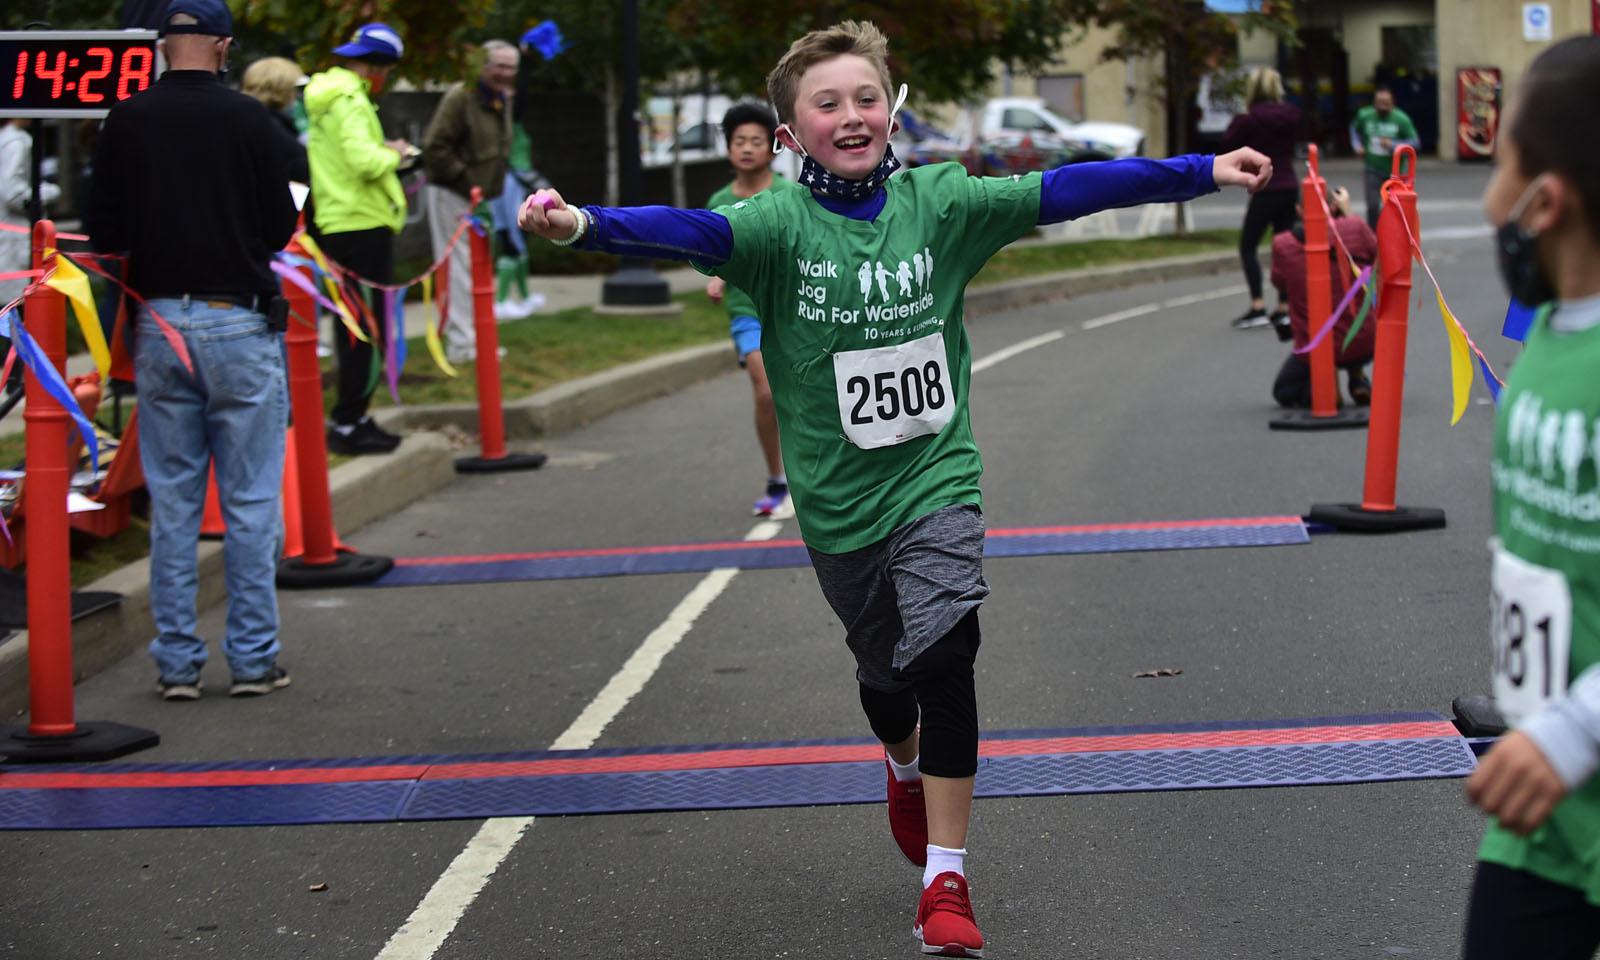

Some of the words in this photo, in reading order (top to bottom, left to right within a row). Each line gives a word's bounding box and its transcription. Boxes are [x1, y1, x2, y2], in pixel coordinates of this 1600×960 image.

[12, 47, 153, 103] 14:28
[797, 258, 838, 278] Walk
[797, 279, 827, 305] Jog
[798, 300, 826, 323] Run
[831, 306, 860, 324] For
[864, 292, 934, 322] Waterside
[864, 327, 879, 340] 10
[880, 328, 905, 340] YEARS
[846, 360, 946, 426] 2508
